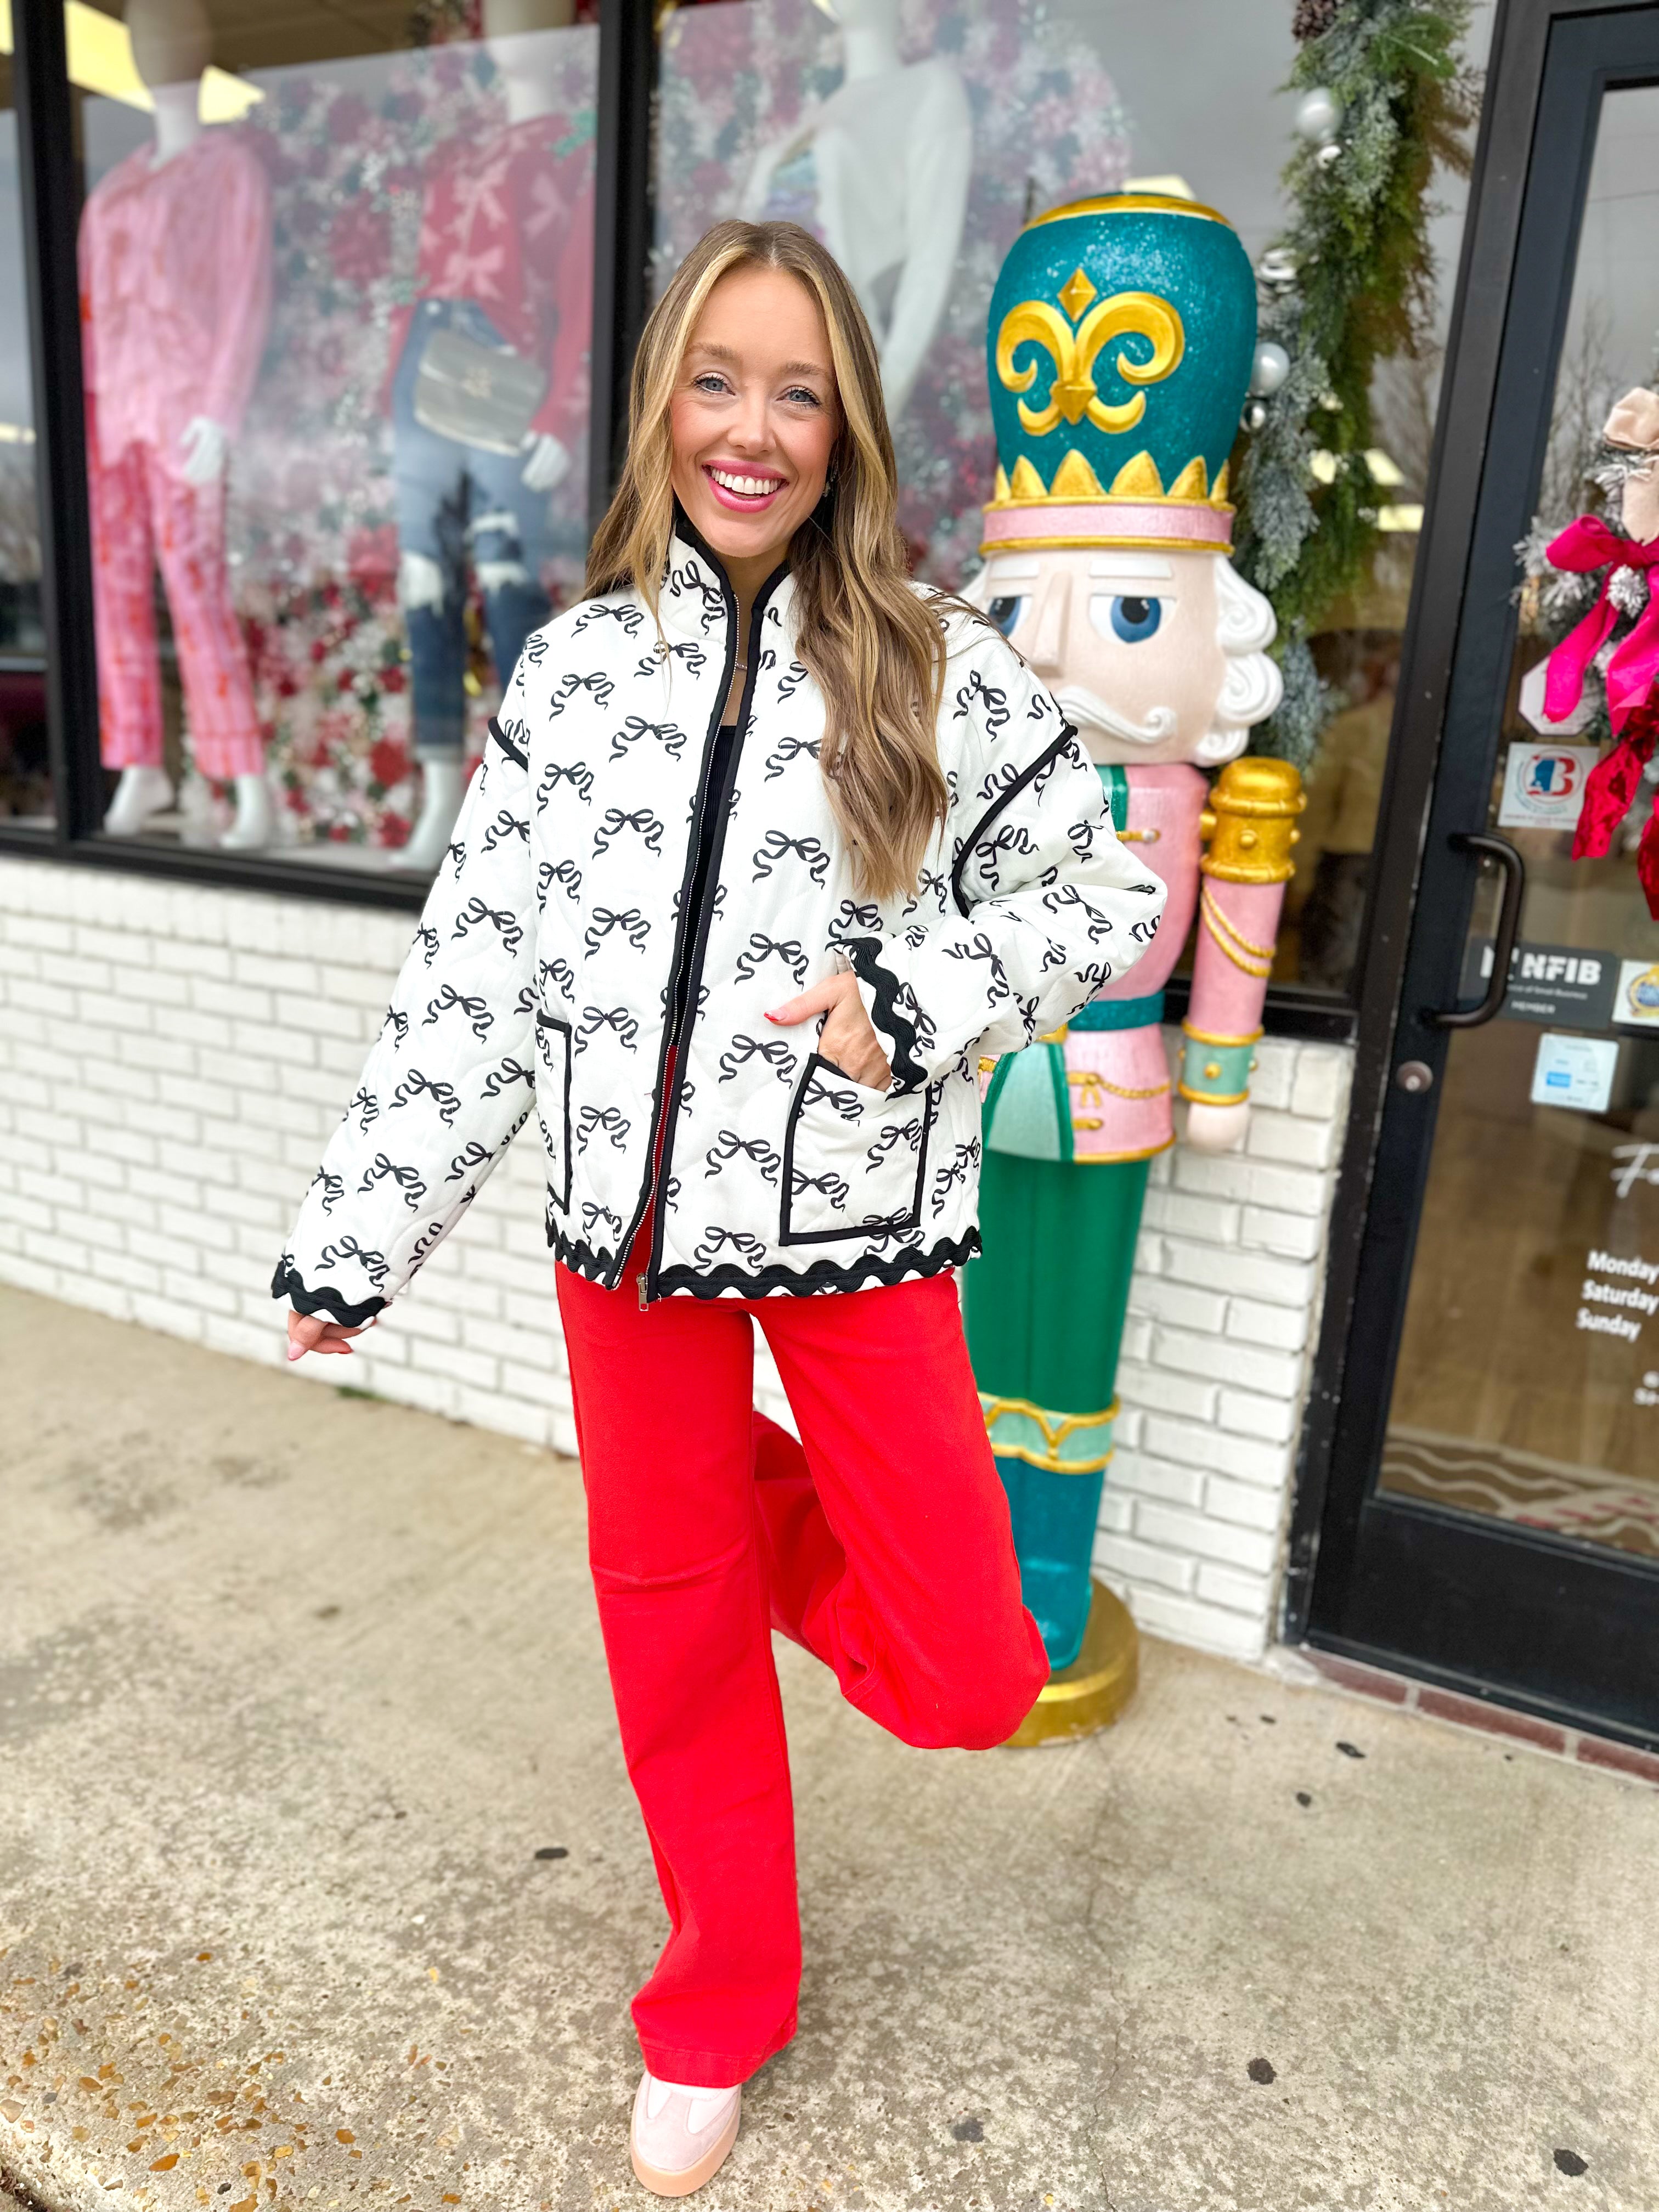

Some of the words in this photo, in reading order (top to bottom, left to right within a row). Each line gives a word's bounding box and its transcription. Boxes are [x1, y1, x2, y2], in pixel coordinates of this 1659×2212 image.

[1521, 952, 1601, 985] NFIB
[1587, 1249, 1659, 1285] Monday
[1582, 1279, 1659, 1316] Saturday
[1576, 1307, 1642, 1342] Sunday
